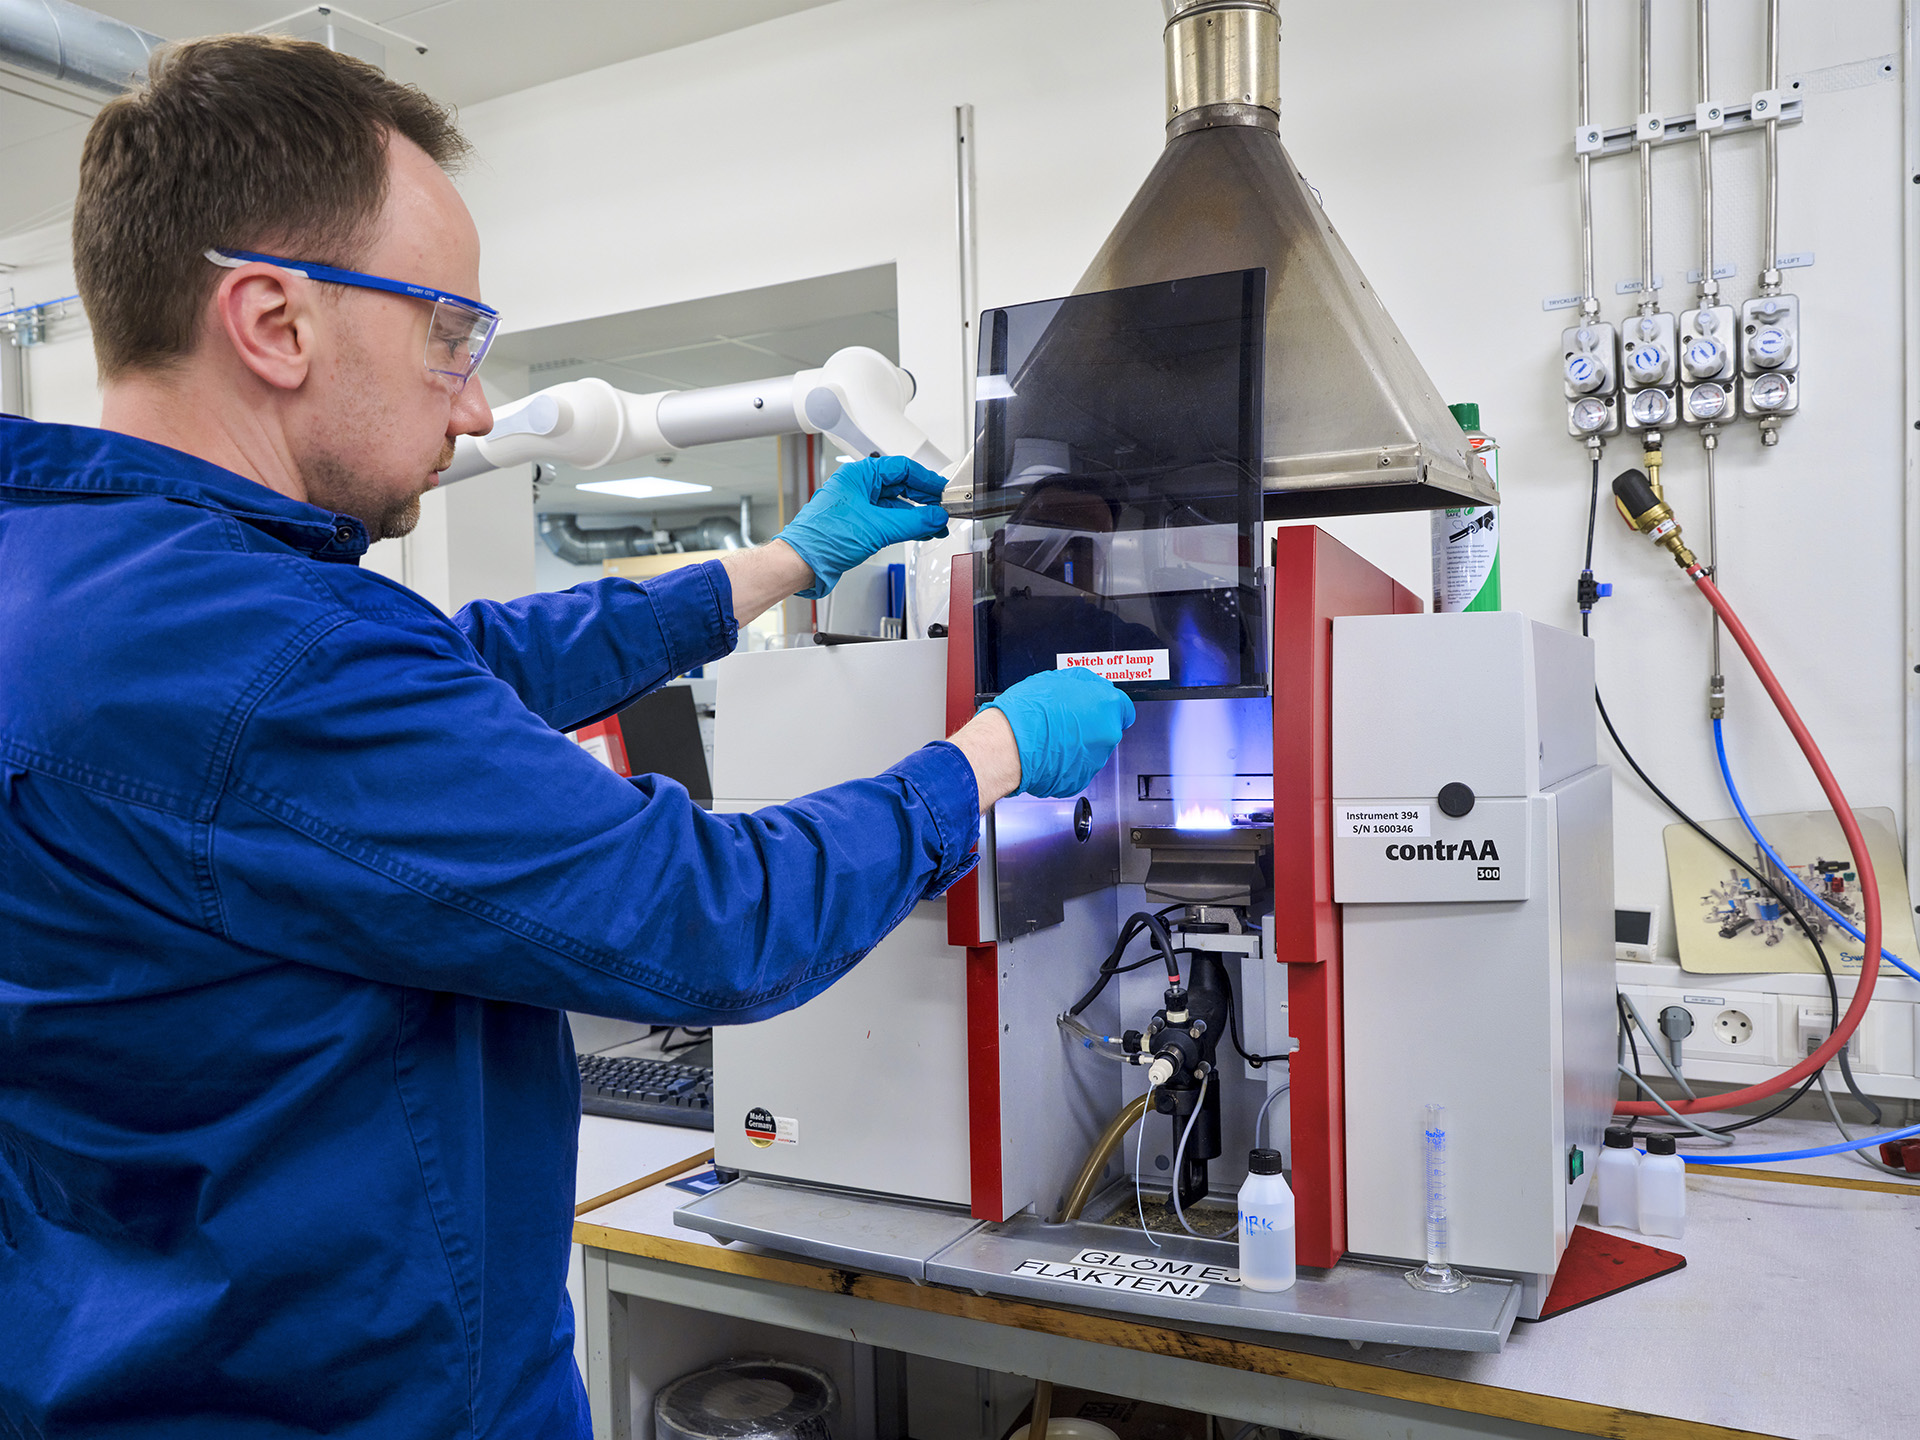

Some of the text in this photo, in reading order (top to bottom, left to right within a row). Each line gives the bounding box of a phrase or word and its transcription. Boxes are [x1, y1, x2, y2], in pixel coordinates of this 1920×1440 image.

[1067, 654, 1154, 667] Switch off lamp
[1105, 668, 1152, 680] analyse!
[1346, 811, 1419, 821] Instrument 394
[1352, 824, 1414, 834] S/N 1600346
[1385, 839, 1500, 861] contrAA
[1478, 868, 1500, 880] 300
[750, 1113, 764, 1121] Made
[748, 1120, 773, 1131] Germany
[1080, 1251, 1242, 1282] GLÖM EJ
[1013, 1260, 1199, 1298] FLÄKTEN!
